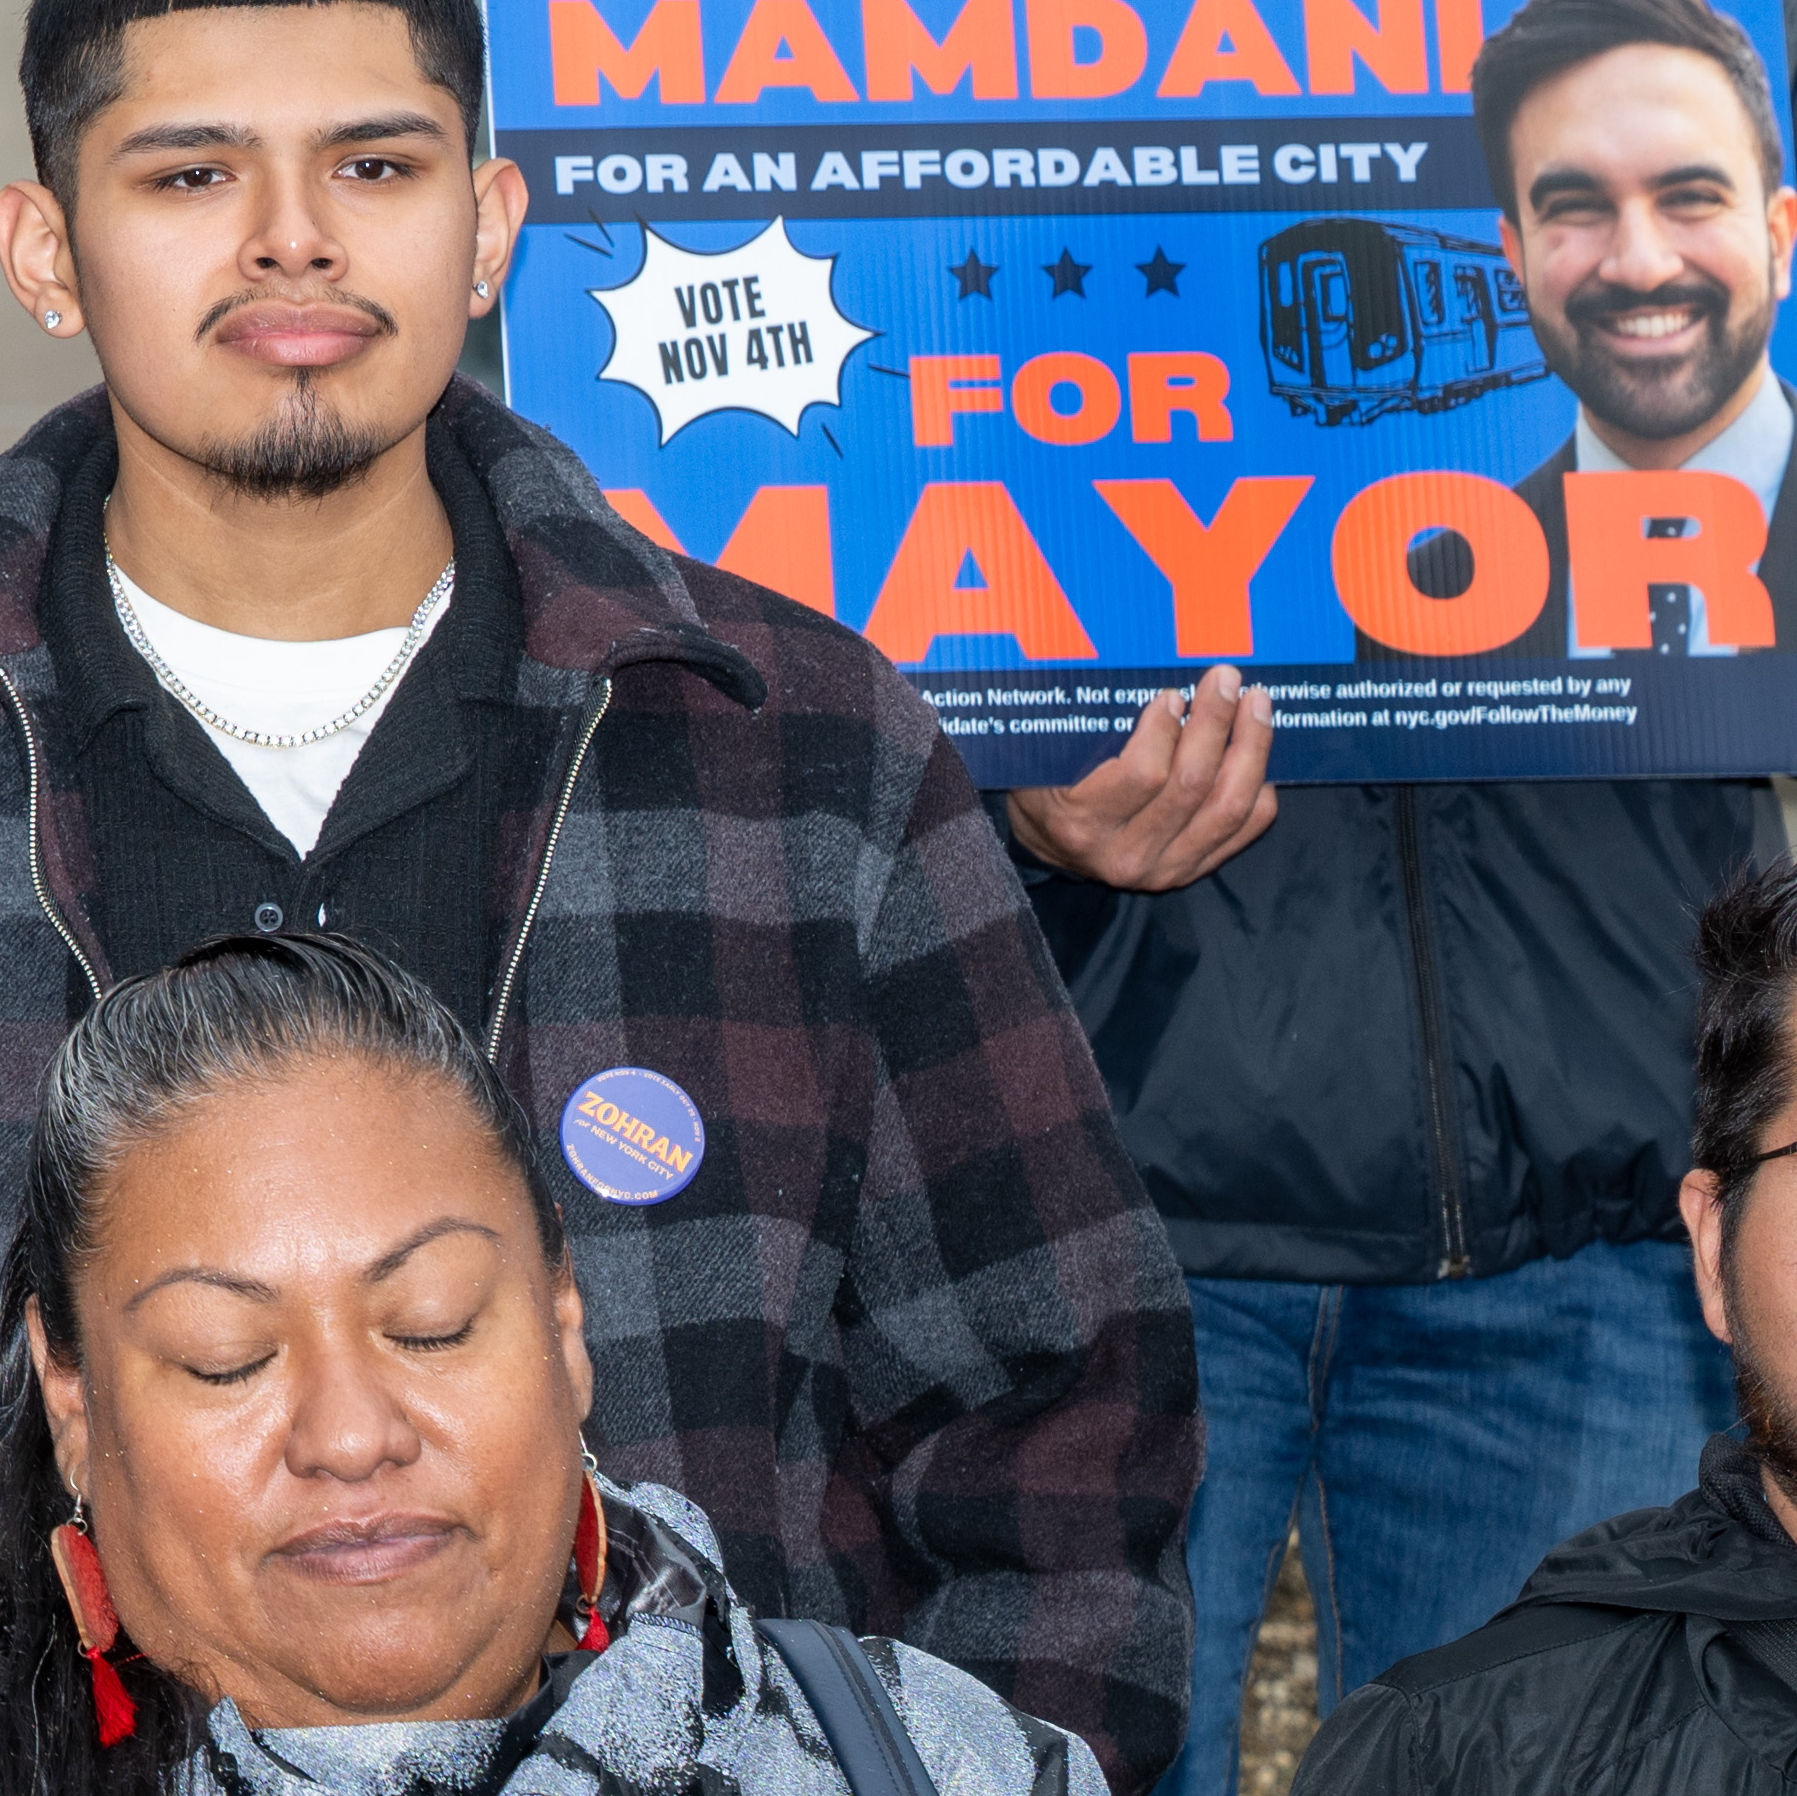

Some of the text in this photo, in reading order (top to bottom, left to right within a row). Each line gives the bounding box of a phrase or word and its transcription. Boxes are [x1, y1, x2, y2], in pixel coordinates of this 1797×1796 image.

[554, 141, 1430, 195] FOR AN AFFORDABLE CITY
[674, 274, 766, 329] VOTE
[658, 320, 814, 385] NOV 4TH
[908, 351, 1234, 446] FOR
[921, 687, 983, 708] Action
[987, 684, 1072, 706] Network.
[1076, 684, 1111, 704] Not
[1335, 678, 1437, 699] authorized
[1442, 681, 1462, 698] or
[1467, 676, 1563, 700] requested
[1567, 675, 1592, 698] by
[1595, 677, 1632, 697] any
[1009, 714, 1111, 734] committee
[1114, 716, 1134, 733] or
[1371, 708, 1390, 726] at
[1395, 703, 1638, 730] nyc.gov/FollowTheMoney
[576, 1090, 693, 1174] ZOHRAN
[591, 1125, 618, 1146] NEW
[618, 1141, 648, 1165] YORK
[647, 1159, 674, 1181] CITY
